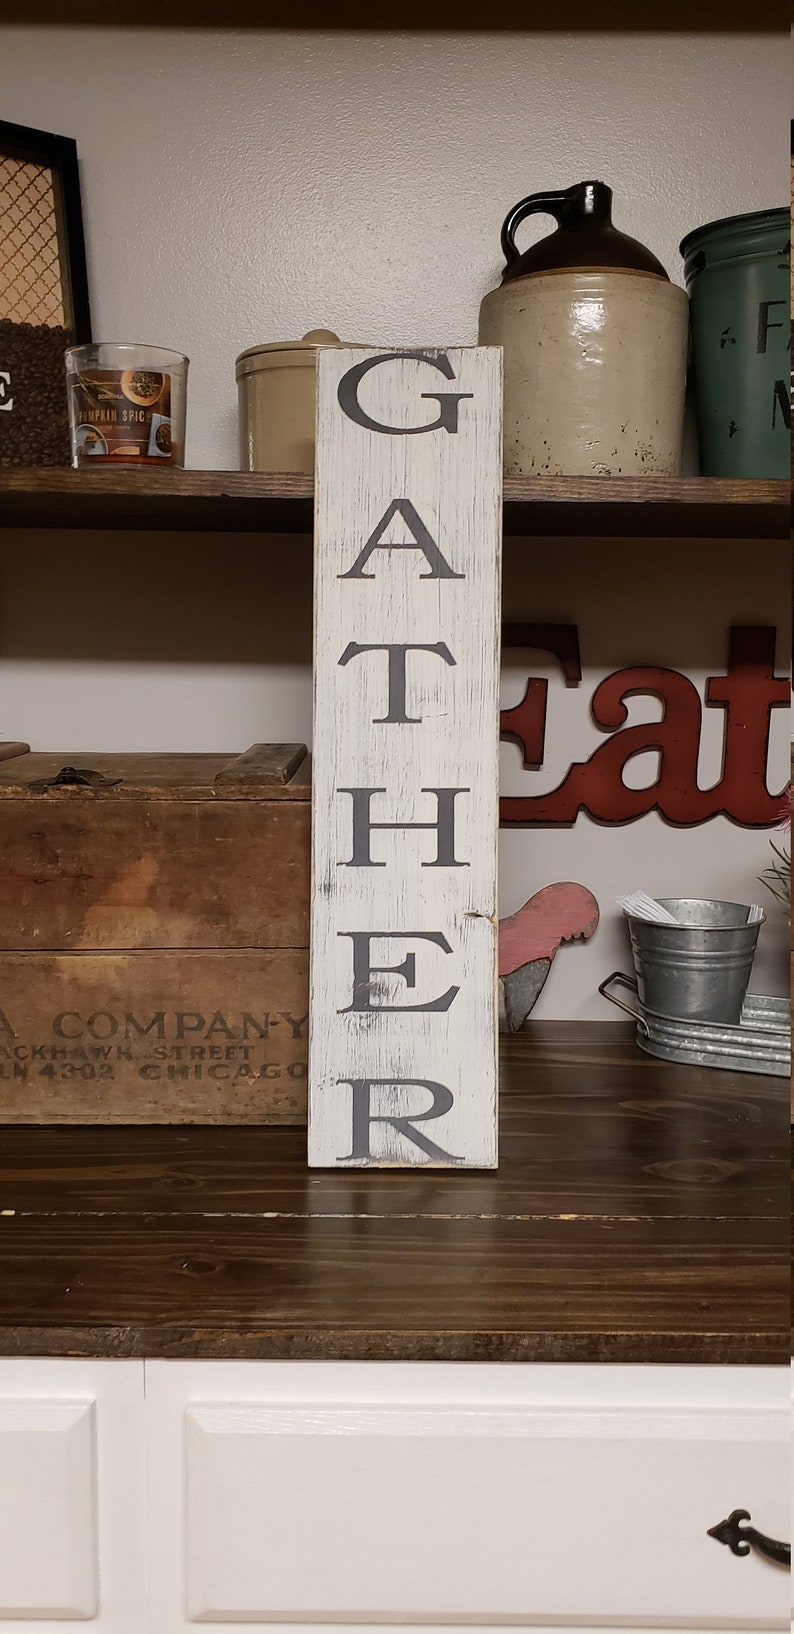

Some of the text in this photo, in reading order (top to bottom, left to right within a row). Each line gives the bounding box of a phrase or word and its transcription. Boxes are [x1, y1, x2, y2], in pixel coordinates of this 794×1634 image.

[78, 409, 151, 422] PUMPKIN SPICE
[499, 624, 790, 829] Eat
[337, 353, 474, 1161] GATHER
[53, 1009, 308, 1040] COMPANY
[153, 1045, 255, 1061] STREET
[138, 1062, 308, 1081] CHICAGO
